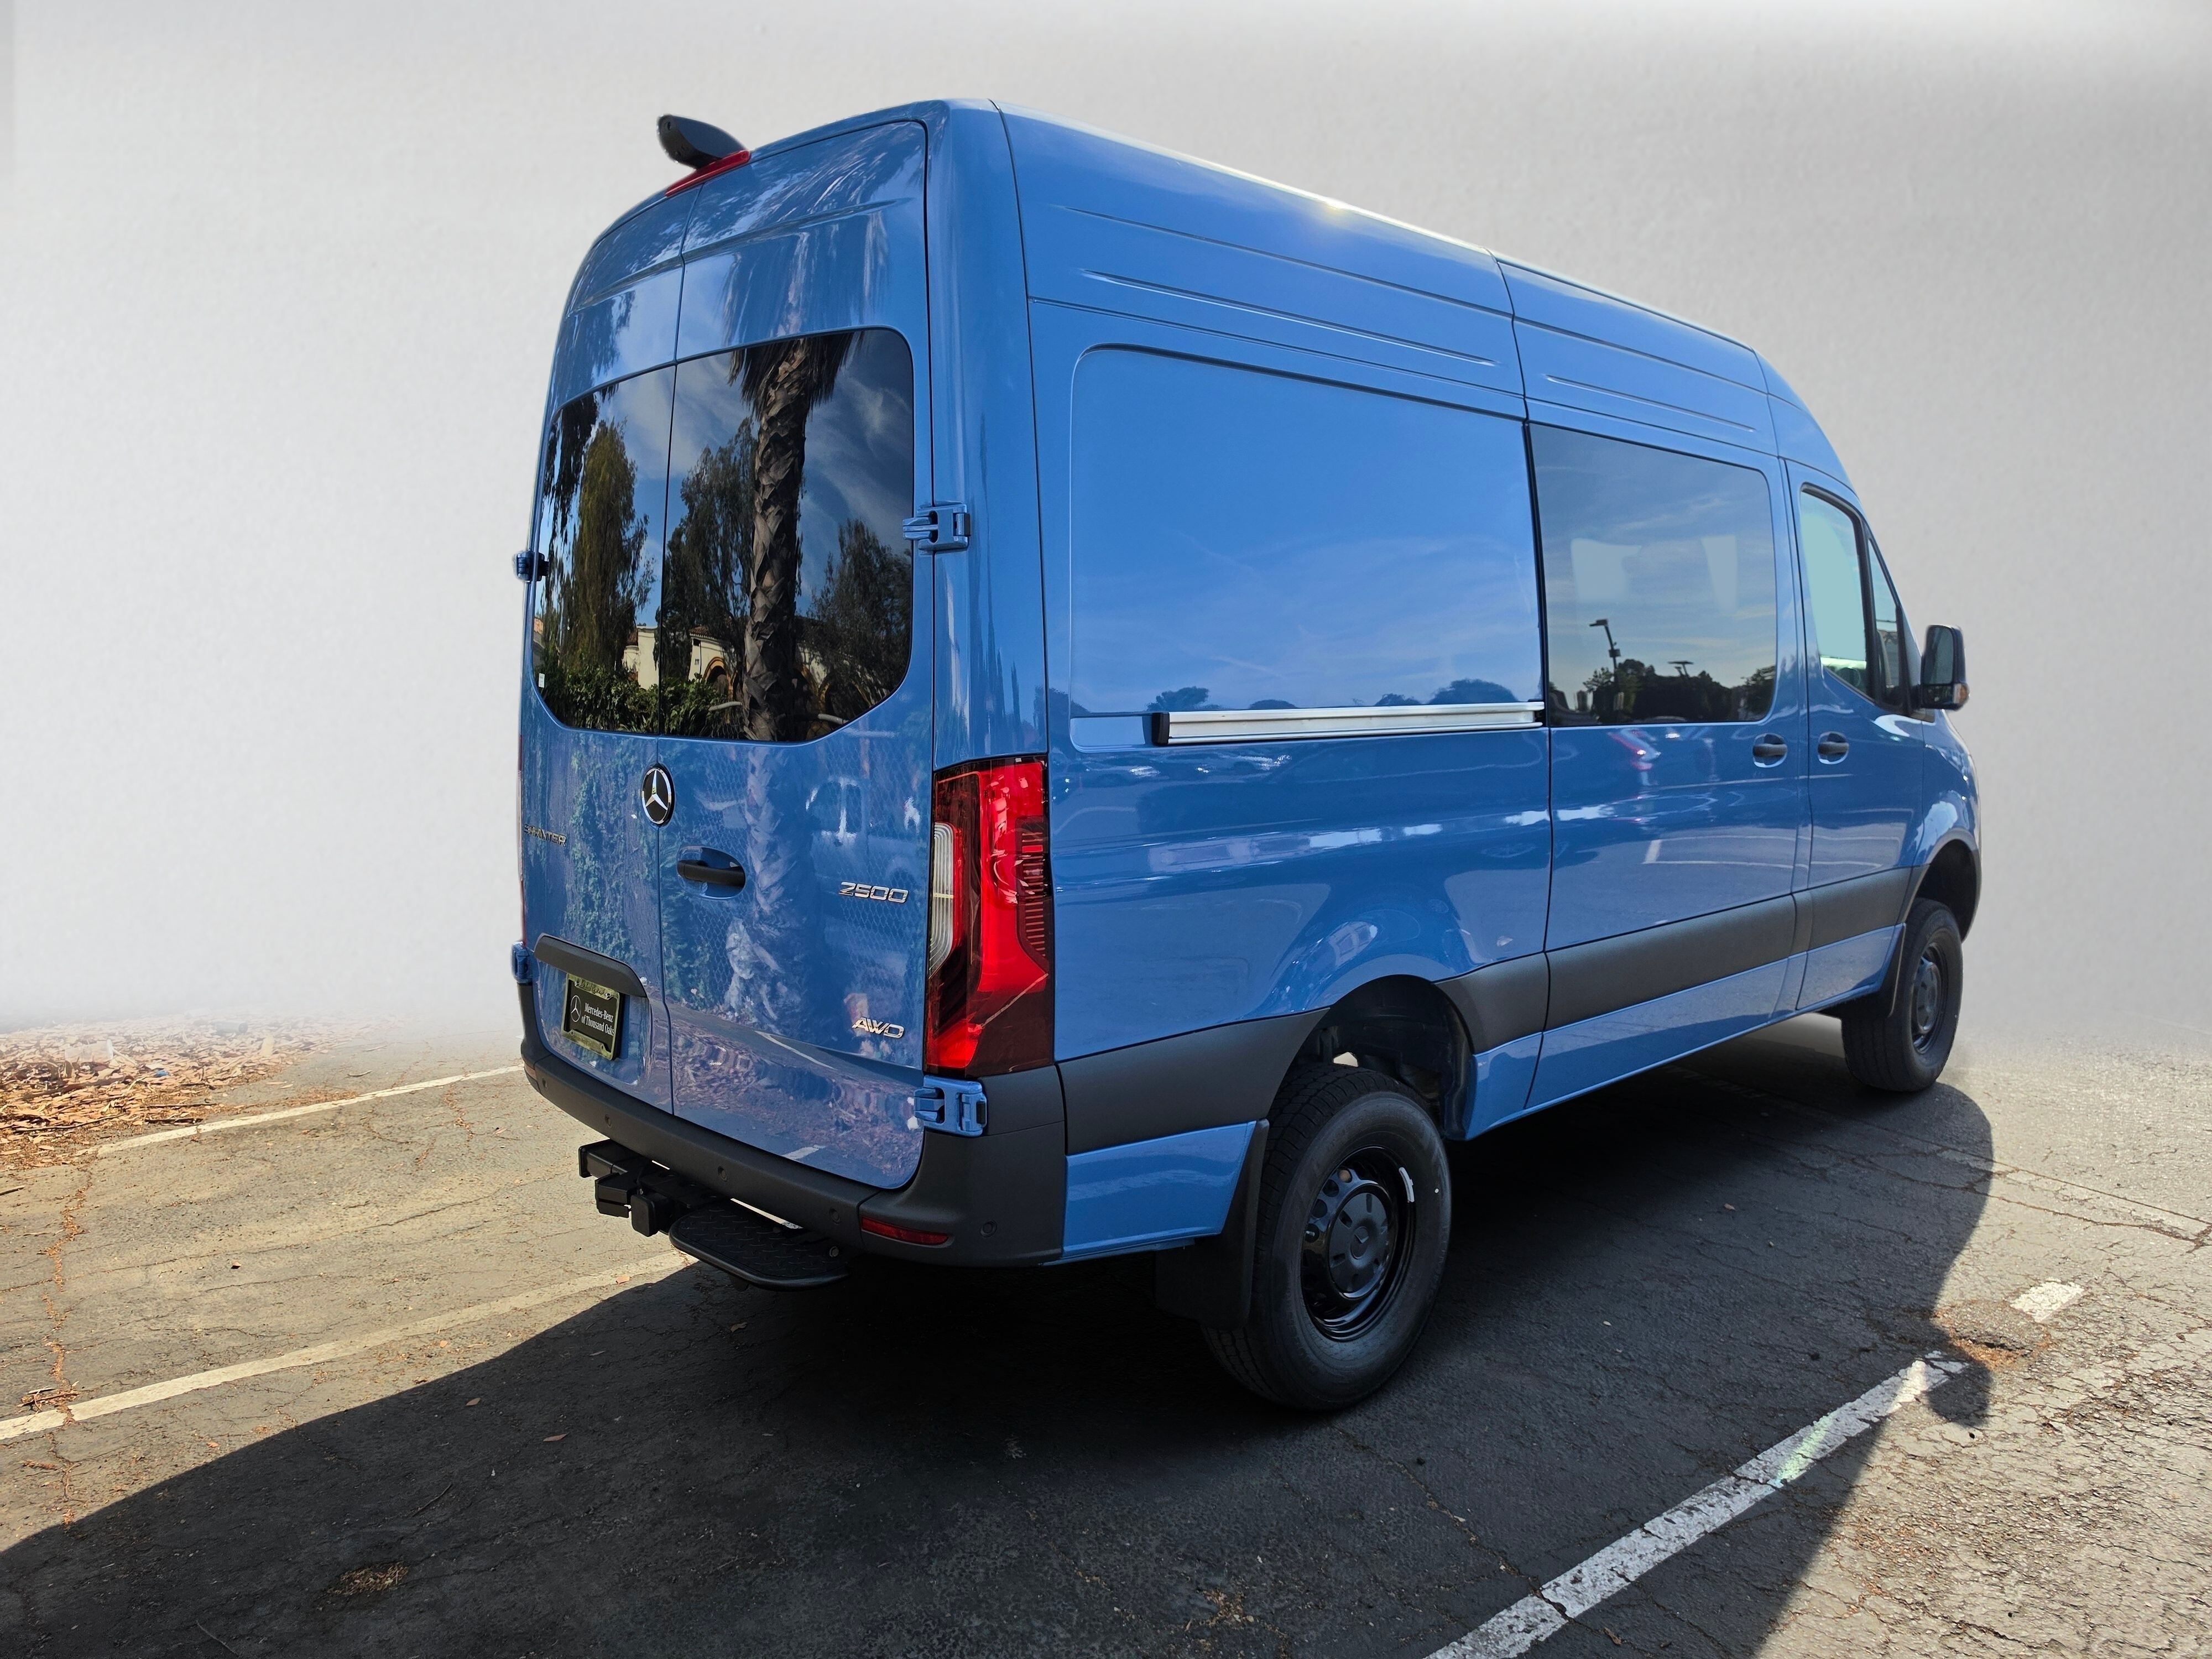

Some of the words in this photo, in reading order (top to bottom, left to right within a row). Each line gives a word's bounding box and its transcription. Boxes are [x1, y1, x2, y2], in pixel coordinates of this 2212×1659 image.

[523, 824, 567, 847] SPRINTER
[838, 881, 909, 903] 2500
[585, 1003, 614, 1022] Mercedes-Benz
[581, 1015, 586, 1024] of
[586, 1016, 604, 1032] Thousand
[605, 1023, 615, 1036] Oaks
[852, 1017, 905, 1039] AWD
